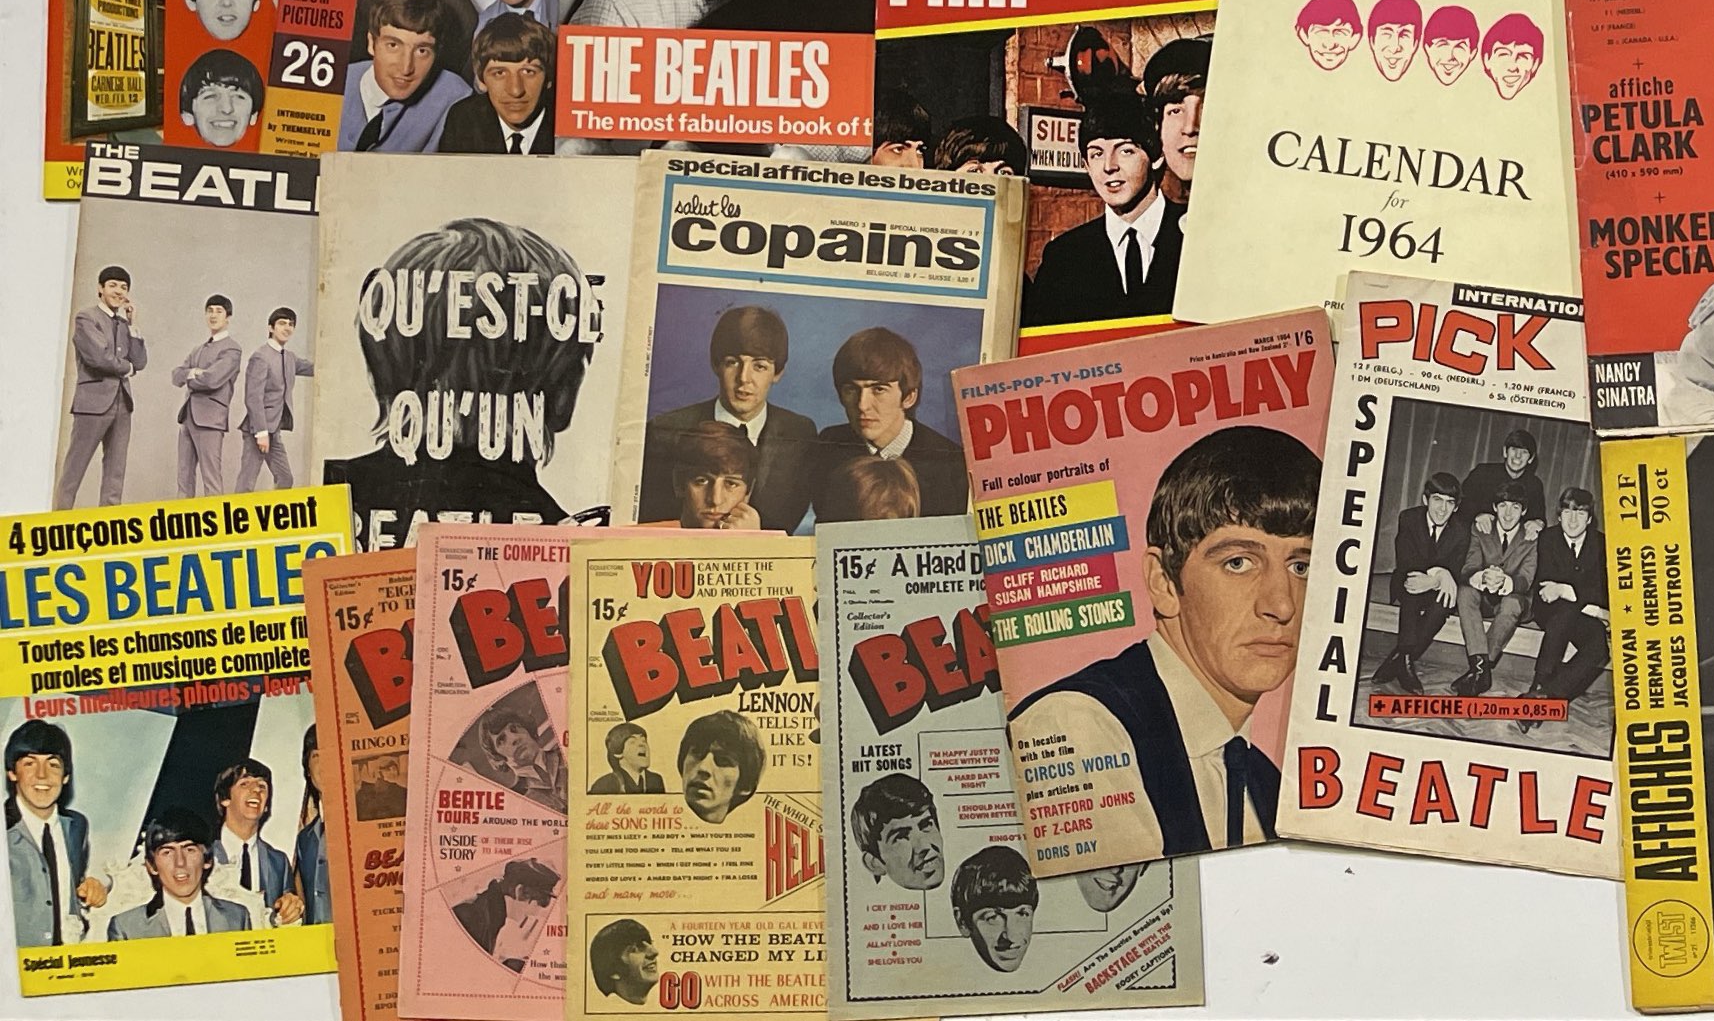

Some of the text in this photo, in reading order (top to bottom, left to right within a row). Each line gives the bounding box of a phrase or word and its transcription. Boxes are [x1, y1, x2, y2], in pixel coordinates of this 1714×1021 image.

[282, 5, 343, 30] PICTURES
[566, 36, 829, 109] THE BEATLES
[1609, 77, 1673, 100] affiche
[572, 110, 831, 137] The most fabulous book
[1581, 98, 1704, 134] PETULA
[1592, 130, 1697, 165] CLARK
[668, 158, 996, 197] spécial affiche les beatles
[1267, 128, 1531, 202] CALENDAR
[671, 217, 981, 272] copains
[1338, 213, 1444, 264] 1964
[360, 266, 605, 343] QU'EST-CE
[1359, 300, 1556, 377] PICK
[1374, 377, 1440, 393] (DEUTSCHLAND)
[1596, 361, 1641, 384] NANCY
[966, 350, 1316, 460] PHOTOPLAY
[1597, 385, 1655, 408] SINATRA
[389, 389, 545, 465] QU'UN
[983, 464, 1095, 492] Full colour portraits
[1011, 496, 1068, 525] BEATLES
[31, 496, 317, 557] garçons dans vent
[1025, 524, 1114, 561] CHAMBERLAIN
[631, 561, 695, 599] YOU
[1617, 546, 1633, 590] ELVIS
[1037, 576, 1101, 600] HAMPSHIRE
[1025, 601, 1125, 638] ROLLING STONES
[133, 658, 217, 686] musique
[1622, 629, 1640, 711] DONOVAN
[185, 681, 249, 710] photos
[739, 691, 814, 715] LENNON
[1391, 697, 1463, 718] AFFICHE
[861, 744, 902, 758] LATEST
[878, 757, 912, 772] SONGS
[1024, 753, 1130, 783] CIRCUS WORLD
[1626, 719, 1698, 882] AFFICHES
[436, 810, 479, 825] TOURS
[483, 816, 518, 826] AROUND
[439, 834, 478, 847] INSIDE
[1037, 846, 1070, 862] DORIS
[1085, 946, 1141, 994] BACKSTAGE
